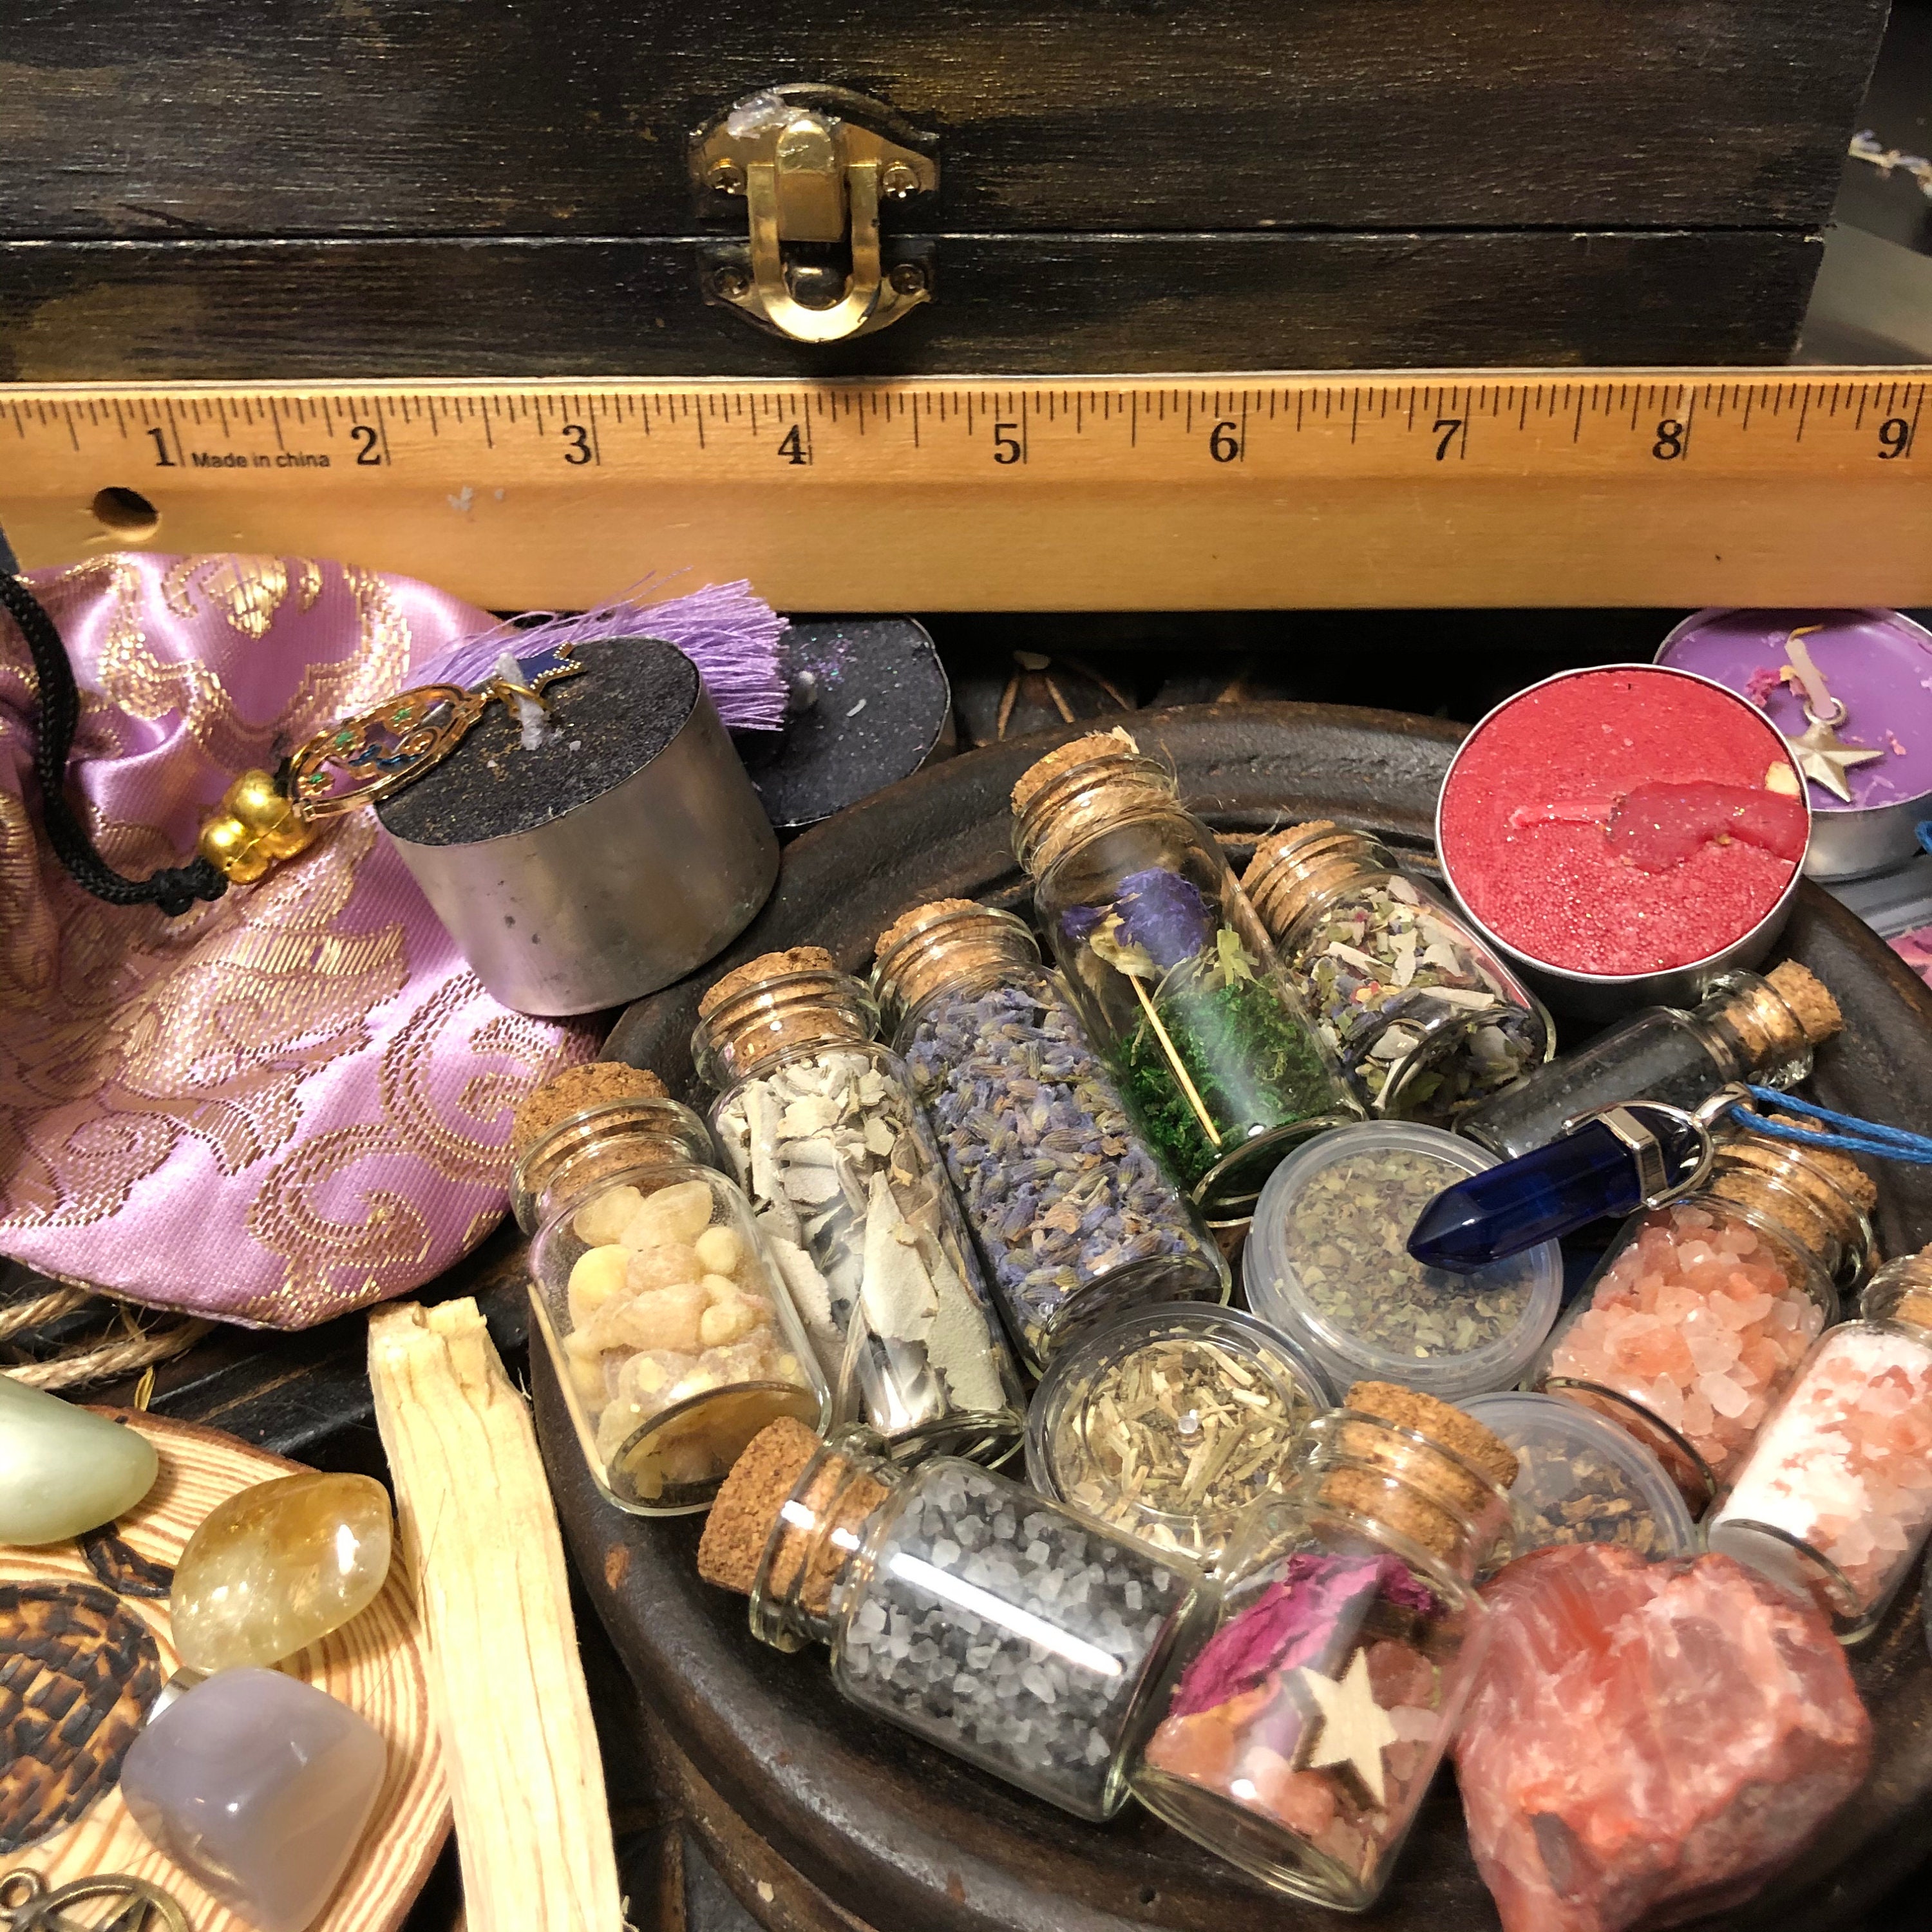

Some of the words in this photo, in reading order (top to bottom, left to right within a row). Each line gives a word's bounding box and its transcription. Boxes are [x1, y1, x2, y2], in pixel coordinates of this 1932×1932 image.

[147, 427, 175, 466] 1
[351, 426, 381, 465] 2
[562, 425, 591, 464] 3
[777, 424, 807, 464] 4
[994, 423, 1021, 464] 5
[1209, 422, 1238, 462] 6
[1433, 420, 1463, 460] 7
[1653, 420, 1683, 459] 8
[1877, 419, 1909, 459] 9
[192, 452, 246, 468] Made
[254, 452, 270, 468] in
[276, 452, 330, 468] china
